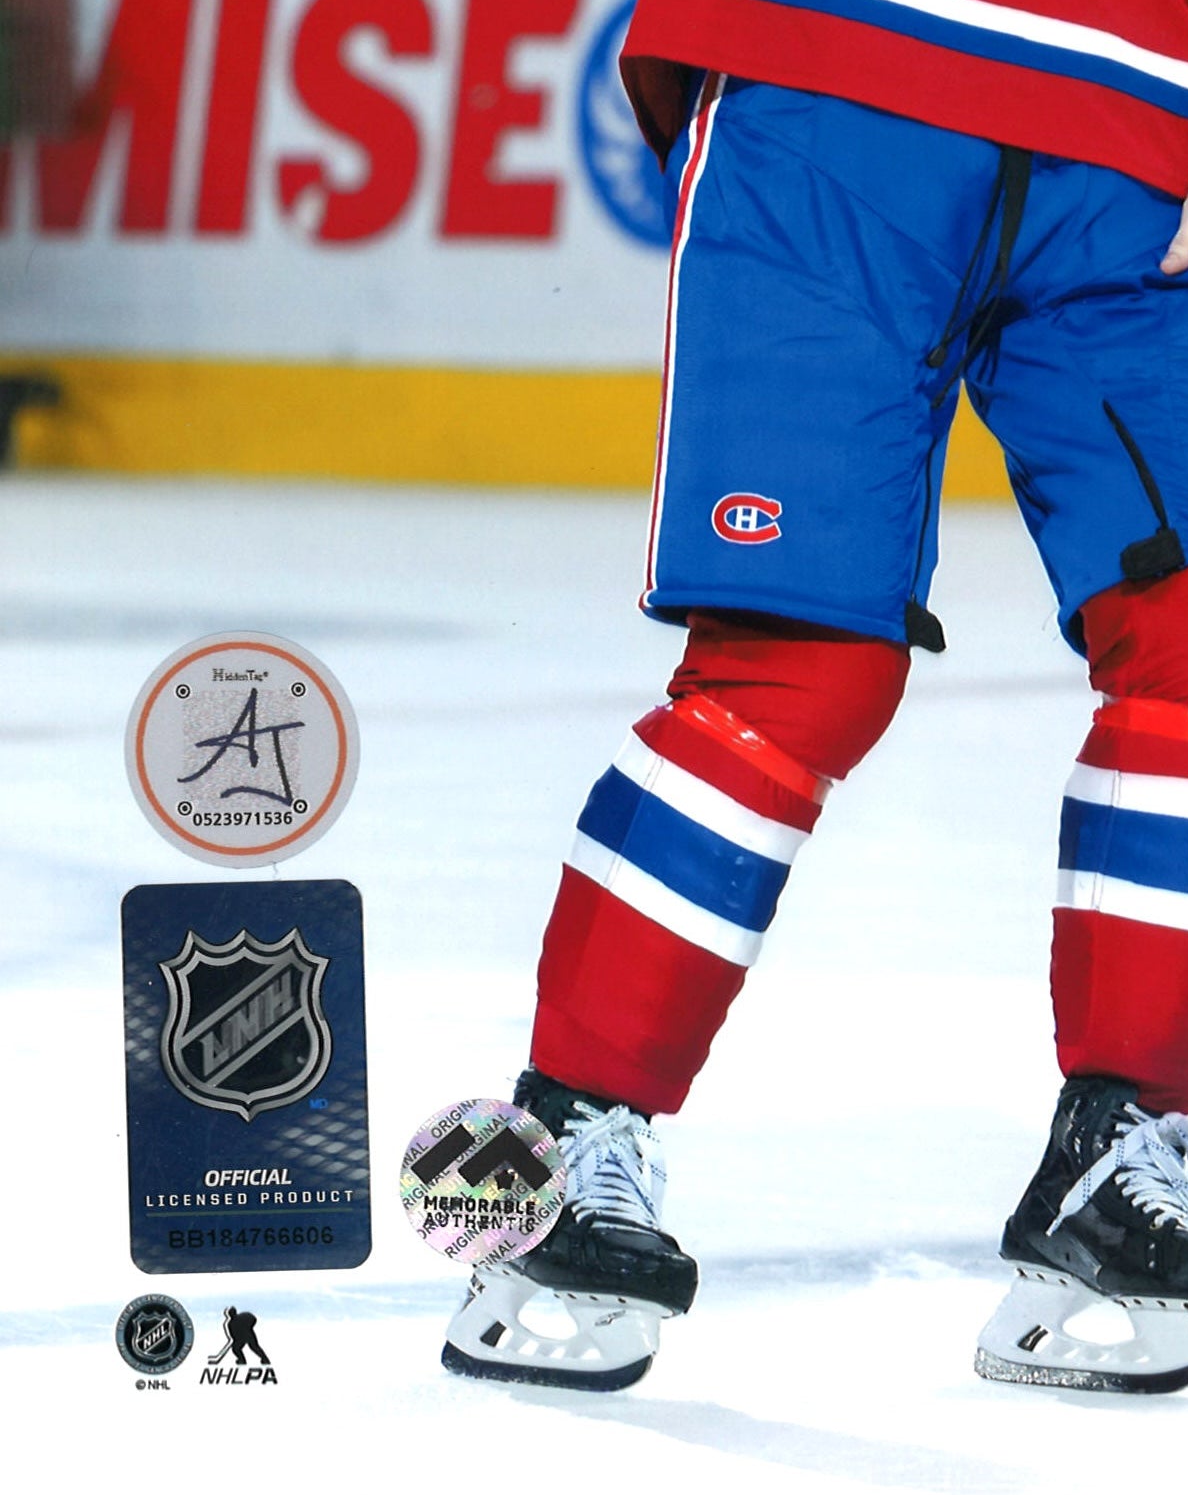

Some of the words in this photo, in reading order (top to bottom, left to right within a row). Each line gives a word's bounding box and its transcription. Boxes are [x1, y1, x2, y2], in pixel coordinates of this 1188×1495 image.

[192, 811, 293, 826] 0523971536
[204, 1168, 293, 1188] OFFICIAL
[145, 1193, 248, 1207] LICENSED
[260, 1190, 354, 1204] PRODUCT
[424, 1196, 536, 1216] MEMORABLE
[168, 1225, 334, 1249] BB184766606
